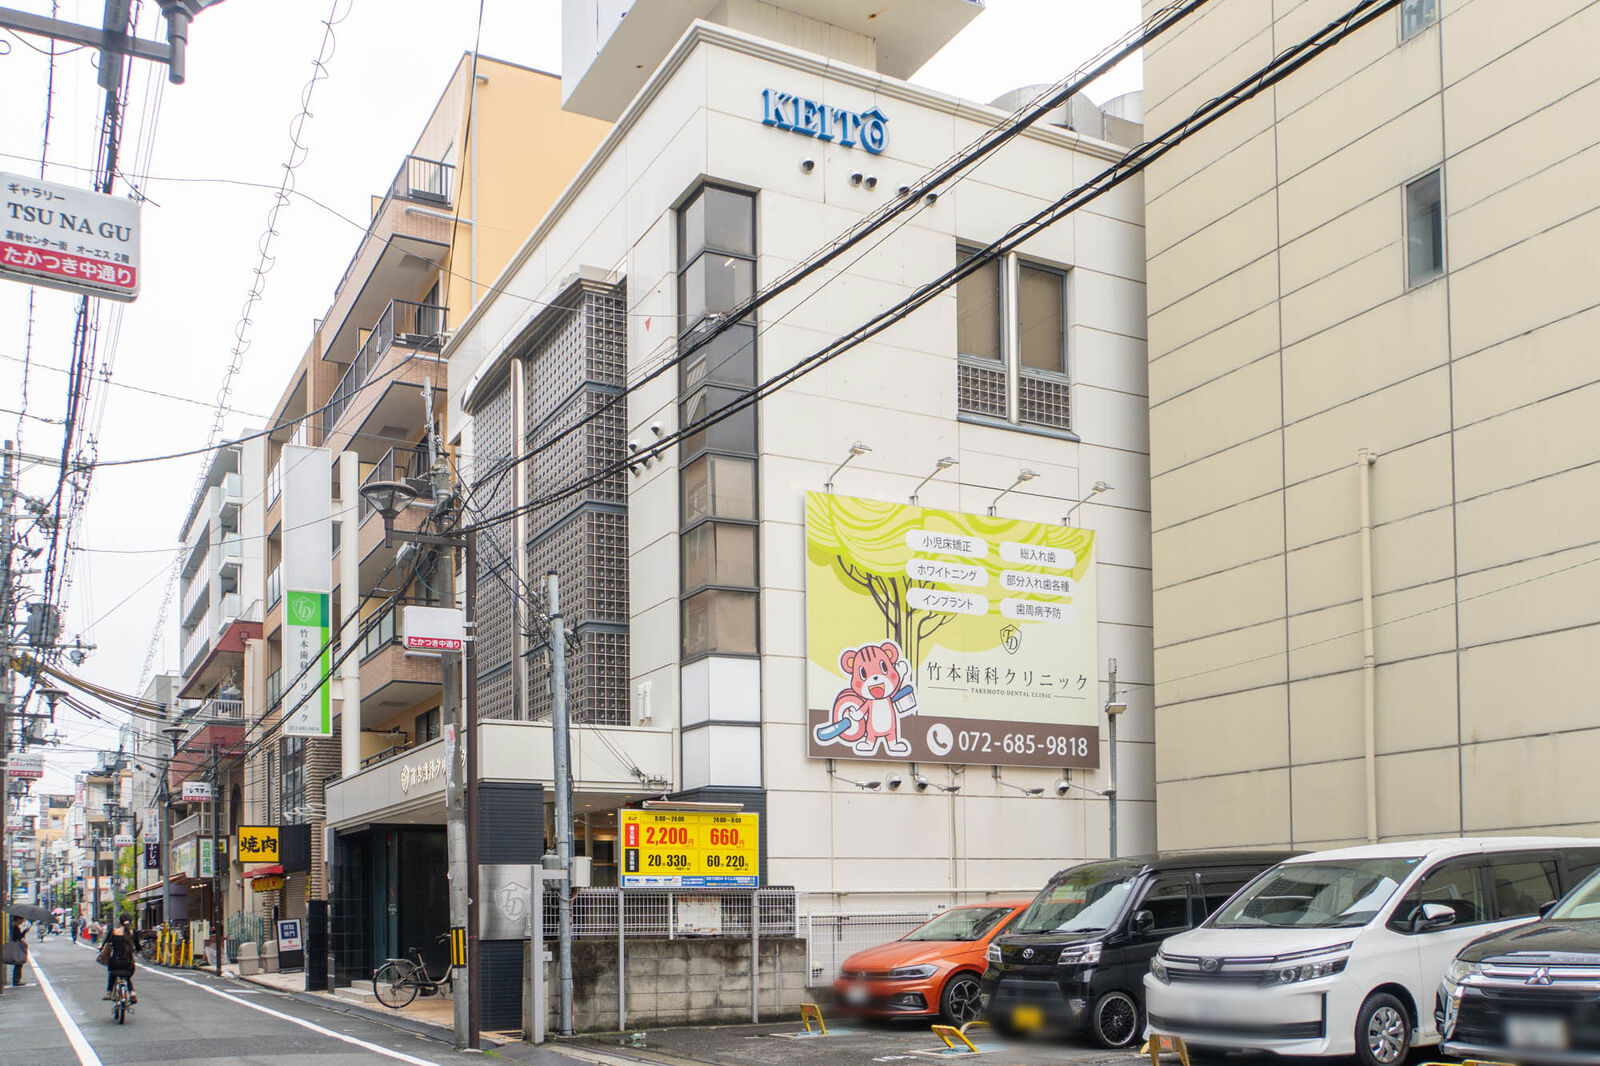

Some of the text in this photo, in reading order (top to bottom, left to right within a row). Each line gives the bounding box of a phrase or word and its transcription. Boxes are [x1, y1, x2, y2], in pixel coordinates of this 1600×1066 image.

[7, 182, 66, 201] ギャラリー
[4, 246, 131, 284] たかつき中通り
[922, 535, 972, 553] 小児床矯正
[1020, 547, 1056, 564] 総入れ歯
[917, 563, 977, 582] ホワイトニング
[1006, 574, 1070, 593] 部分入れ歯各種
[923, 593, 973, 610] インプラント
[1016, 603, 1062, 619] 歯周病予防
[409, 637, 461, 649] たかつき中通り
[926, 661, 1087, 691] 竹本歯科クリニック
[970, 687, 1052, 699] TAKEMOTO DENTAL CLINIC
[958, 730, 1088, 757] 072-685-9818
[240, 835, 278, 853] 焼肉
